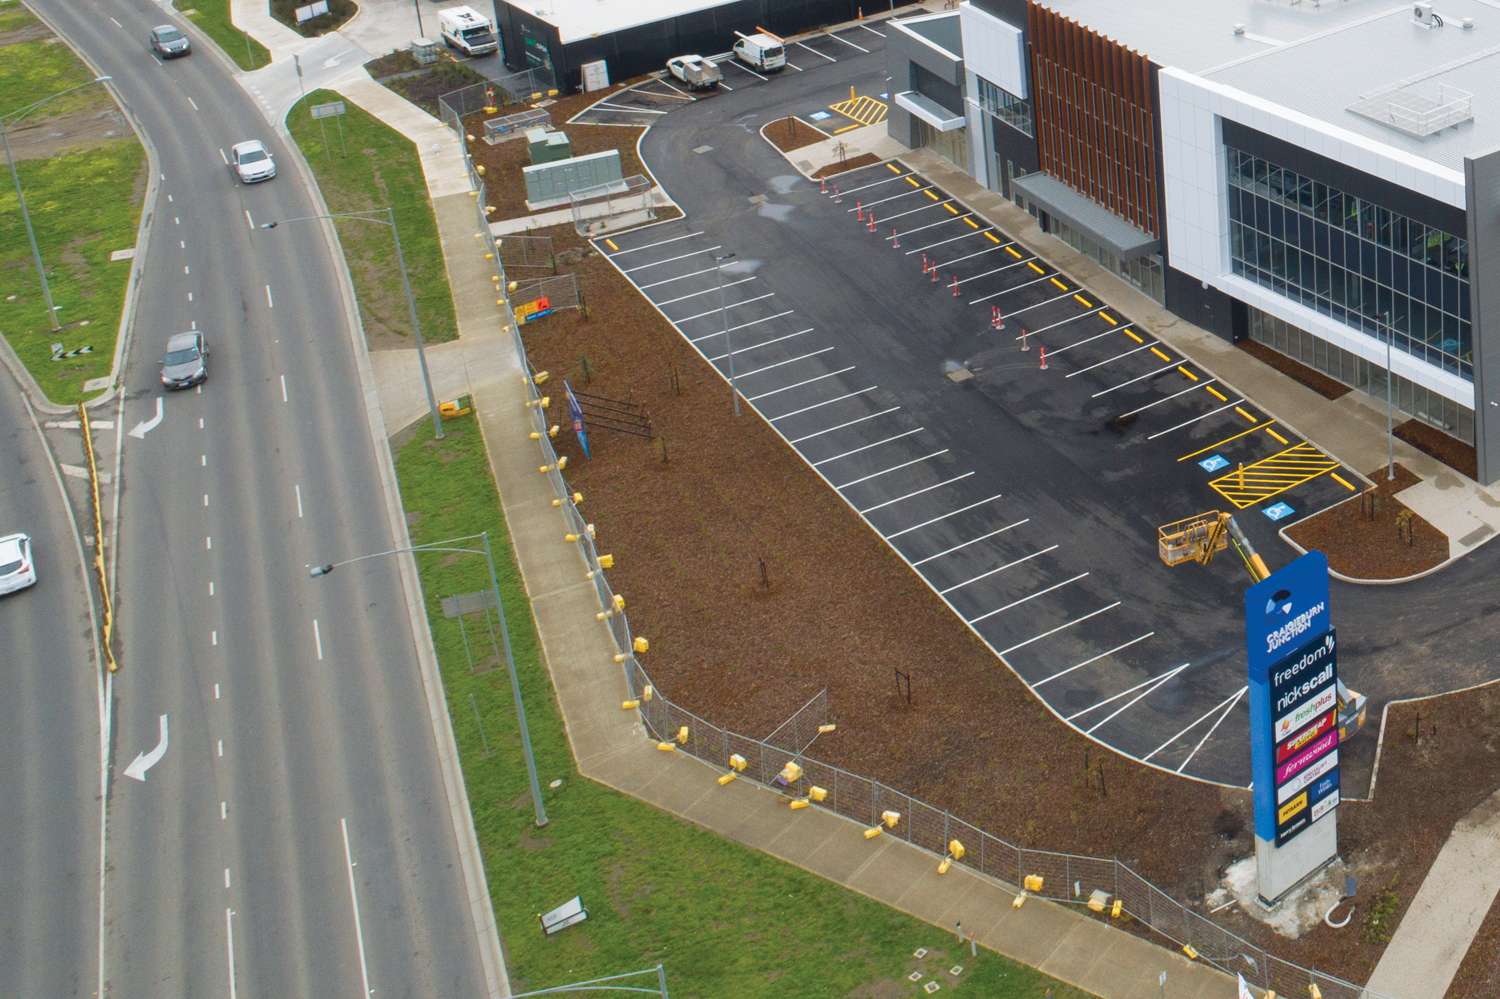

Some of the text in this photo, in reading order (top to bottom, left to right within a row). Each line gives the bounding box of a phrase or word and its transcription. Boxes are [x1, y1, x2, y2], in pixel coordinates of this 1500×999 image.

[1266, 602, 1324, 644] CRAIGIEBURN
[1266, 618, 1311, 653] JUNCTION
[1274, 646, 1326, 687] freedom
[1277, 663, 1333, 712] nickscali
[1295, 693, 1332, 722] freshplus
[1287, 717, 1327, 750] SUPERCHEAP
[1283, 735, 1332, 778] fernwood
[1283, 799, 1303, 817] PETBARN
